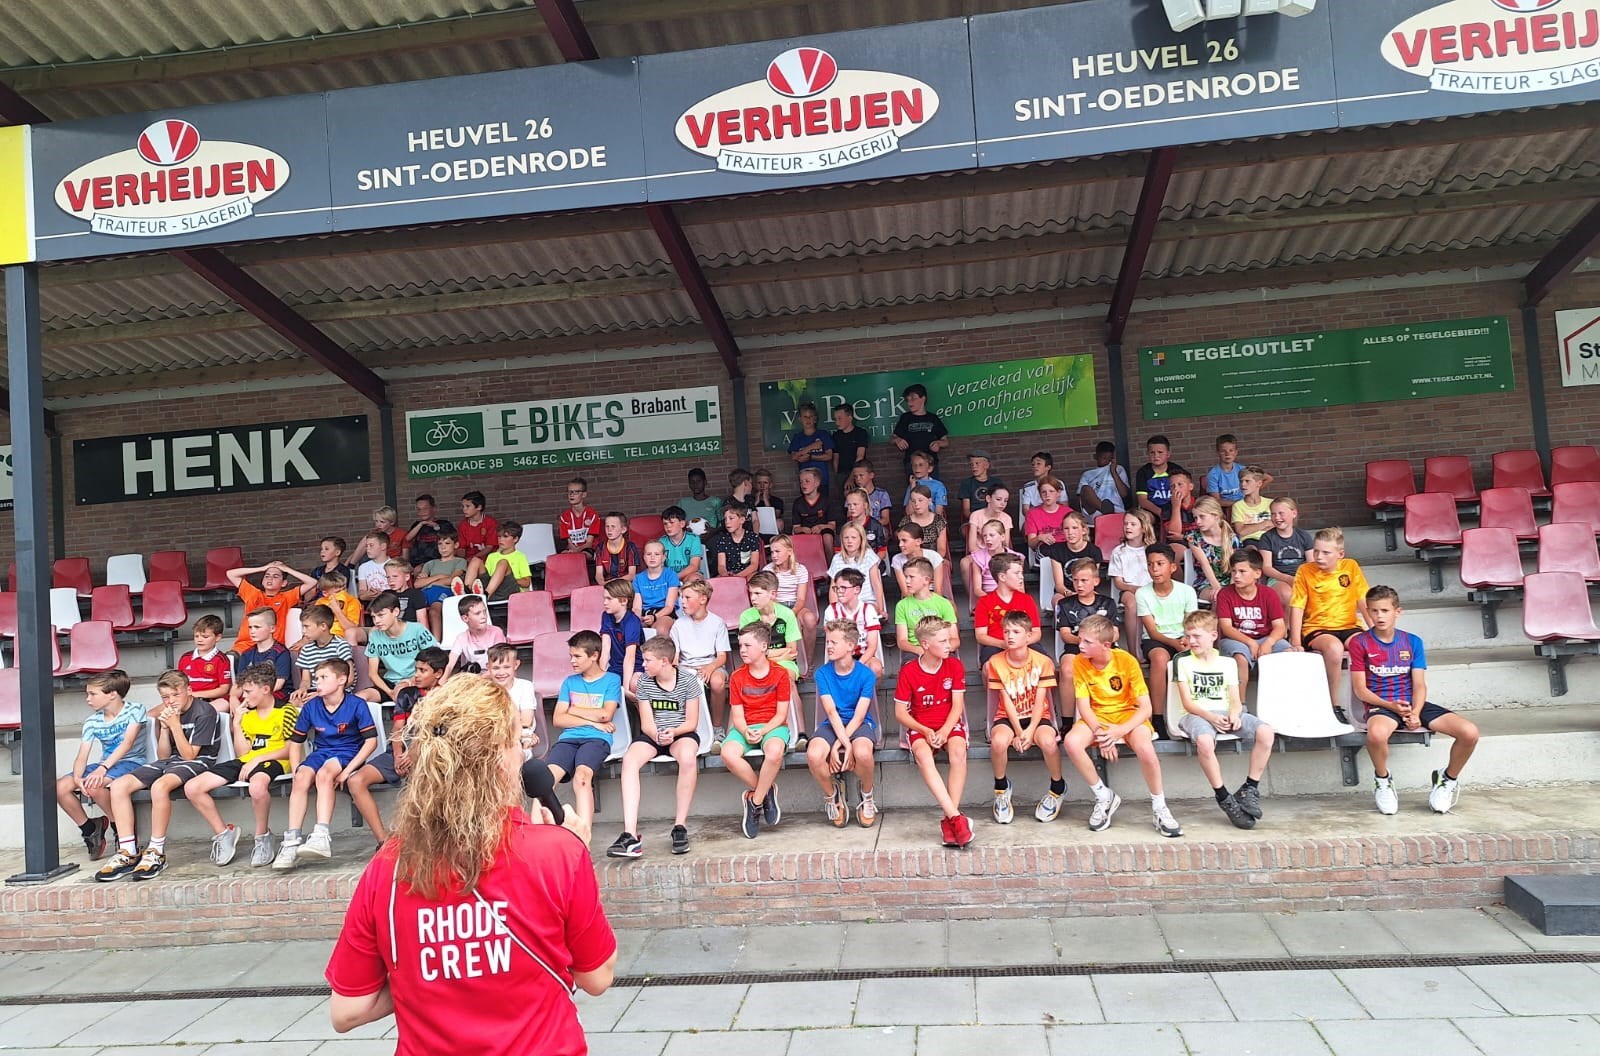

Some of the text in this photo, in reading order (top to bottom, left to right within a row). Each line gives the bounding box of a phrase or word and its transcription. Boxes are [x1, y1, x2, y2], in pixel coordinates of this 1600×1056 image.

[1071, 38, 1240, 79] HEUVEL 26
[1438, 72, 1531, 90] TRAITEUR
[1549, 62, 1600, 86] SLAG
[1014, 66, 1301, 122] SINT-OEDENRODE
[407, 117, 554, 153] HEUVEL 26
[684, 87, 924, 149] VERHEIJEN
[357, 145, 607, 192] SINT-OEDENRODE
[724, 152, 804, 171] TRAITEUR
[819, 136, 893, 168] SLAGERIJ
[63, 158, 276, 212] VERHEIJEN
[97, 216, 168, 234] TRAITEUR
[181, 201, 249, 231] SLAGERIJ
[1182, 338, 1315, 362] TEGELOUTLET
[1362, 327, 1490, 345] ALLES OP TEGELGEBIED!!!
[947, 363, 1055, 398] Verzekerd van
[1154, 373, 1197, 382] SHOWROOM
[1154, 386, 1185, 395] OUTLET
[1411, 373, 1494, 385] WWW.TEGELOUTLET.NL
[631, 396, 687, 416] Brabant
[936, 375, 1075, 419] een onafhankelijk
[1155, 397, 1186, 405] MONTAGE
[501, 400, 625, 447] E BIKES
[983, 405, 1033, 428] advies
[122, 426, 321, 495] HENK
[411, 440, 720, 475] NOORDKADE 3B 5462 EC VEGHEL TEL. 0413-413452
[1233, 606, 1263, 620] PARIS
[1193, 674, 1224, 687] PUSH
[1369, 664, 1411, 675] Rakuten
[652, 700, 678, 710] BREAK
[416, 900, 510, 944] RHODE
[420, 936, 512, 982] CREW
